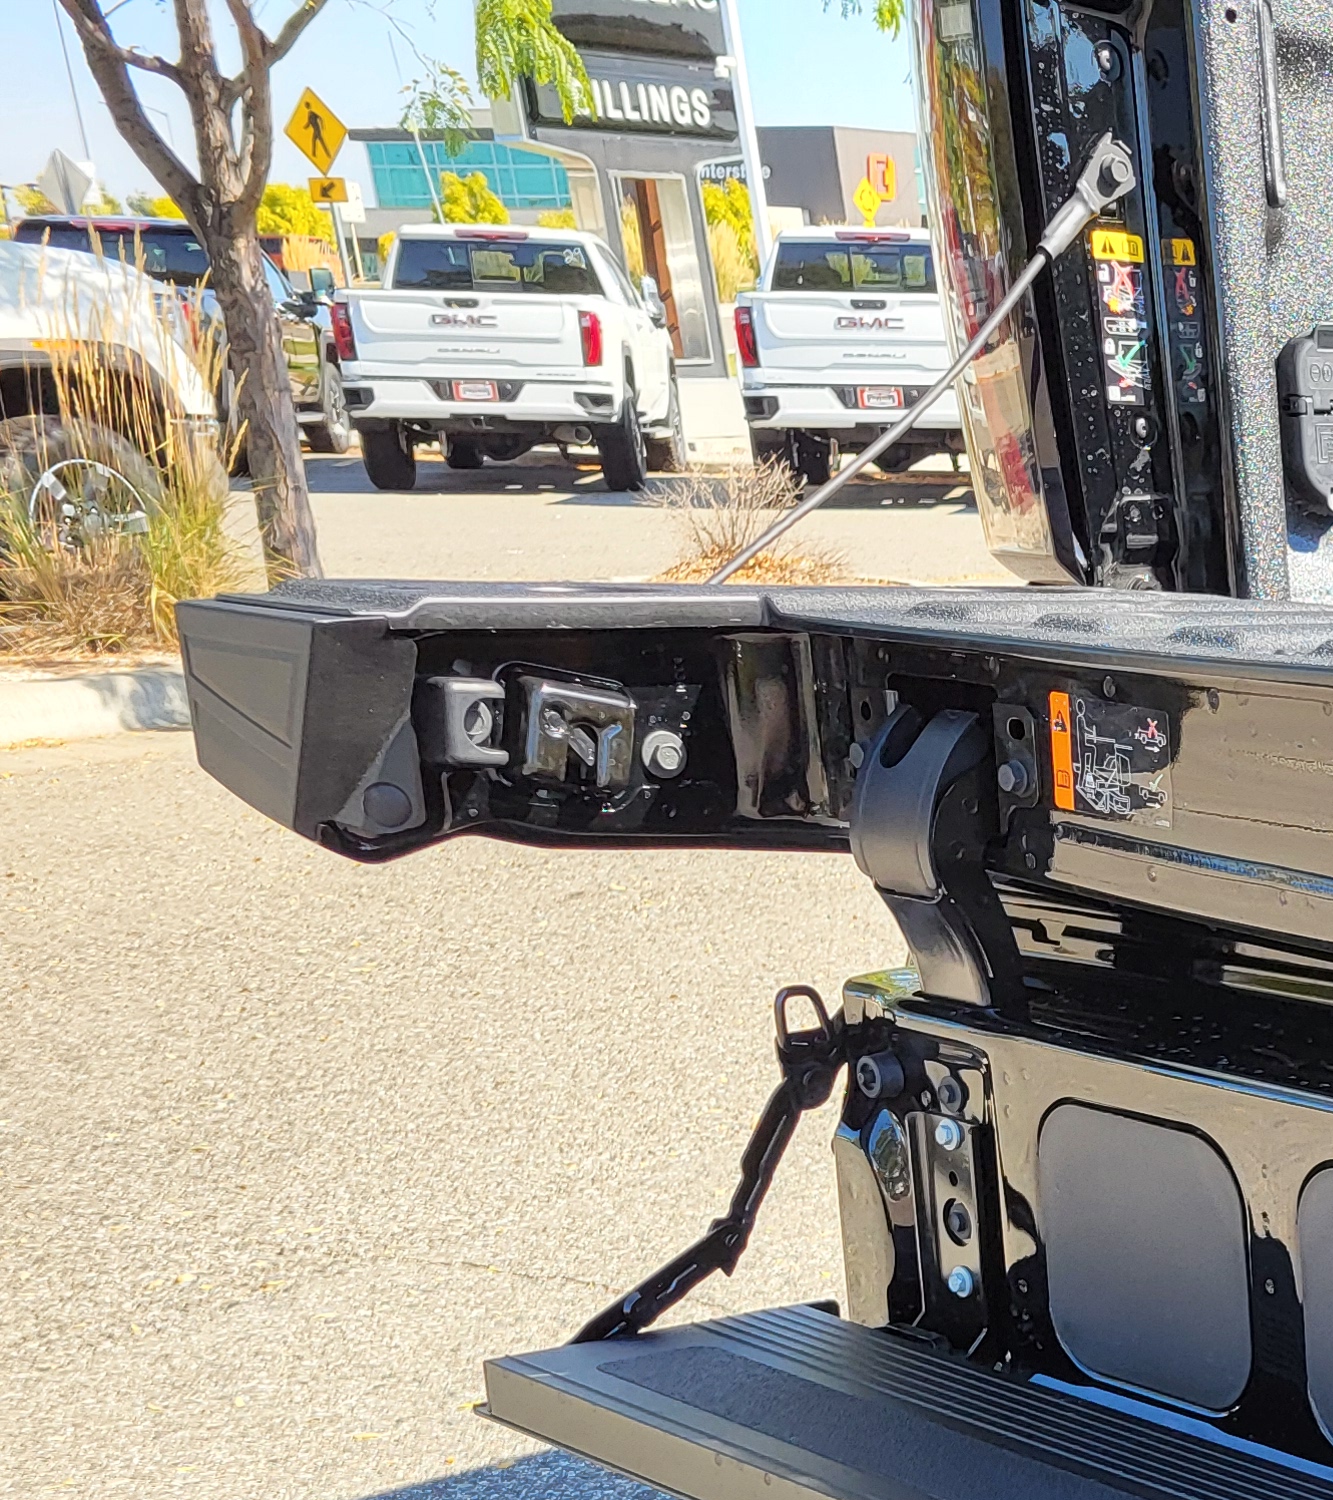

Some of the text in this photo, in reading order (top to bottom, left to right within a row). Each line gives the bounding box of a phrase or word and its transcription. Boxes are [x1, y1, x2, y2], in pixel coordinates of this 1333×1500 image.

[700, 163, 771, 179] nterste
[429, 313, 498, 328] GMC
[834, 316, 905, 330] GMC
